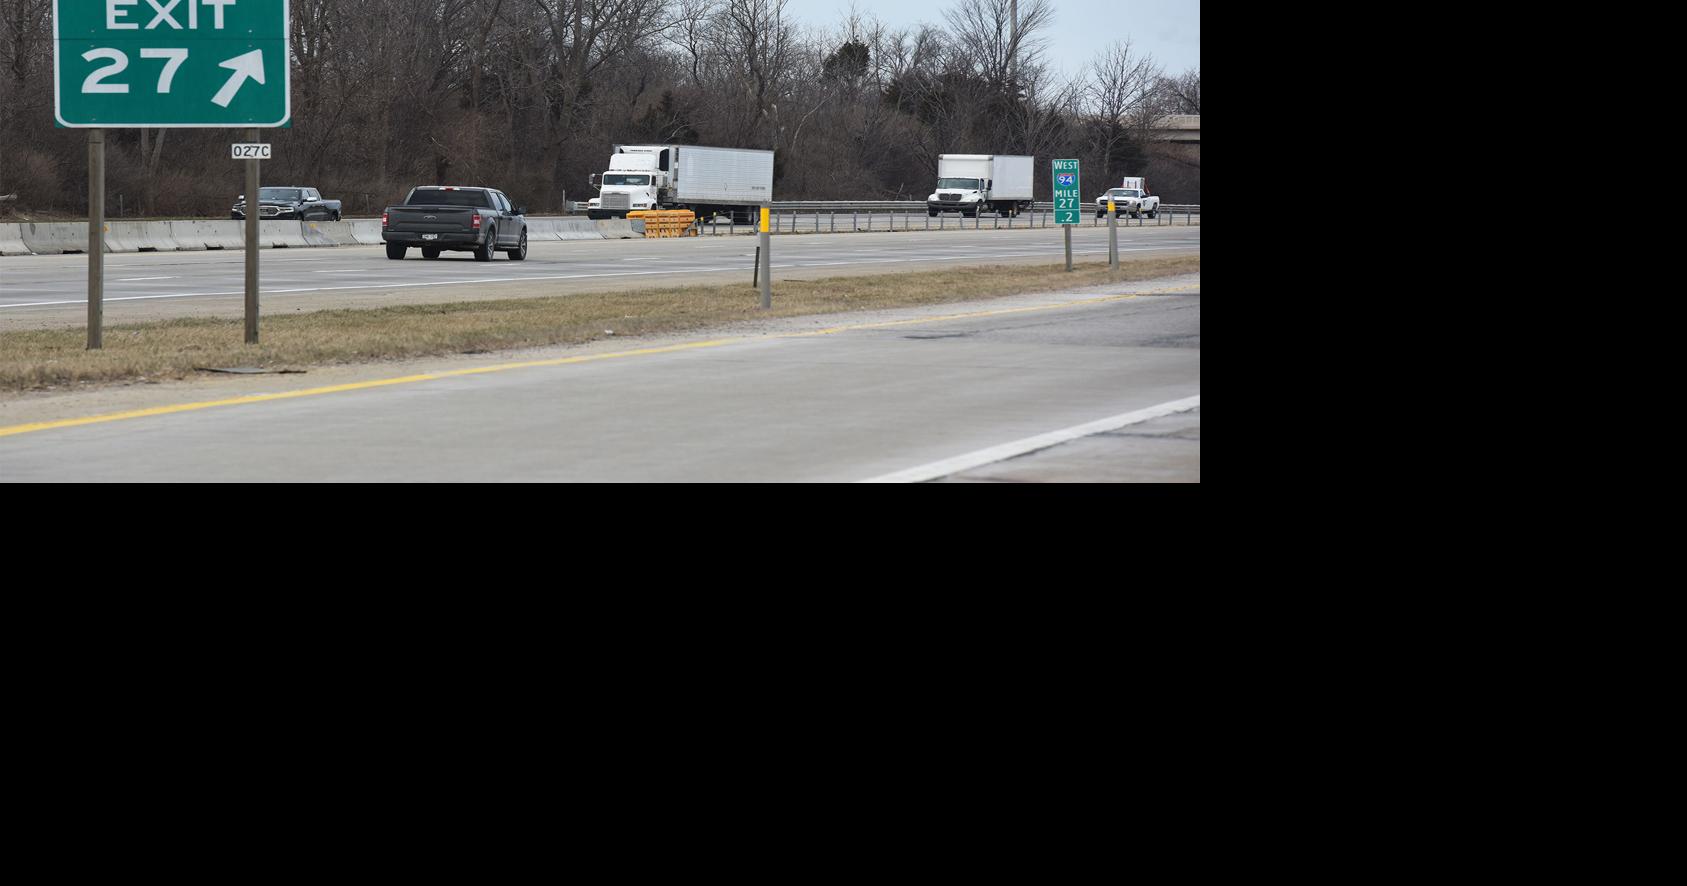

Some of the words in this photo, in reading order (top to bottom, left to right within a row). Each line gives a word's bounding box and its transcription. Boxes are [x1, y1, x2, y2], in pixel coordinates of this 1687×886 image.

[106, 0, 236, 30] EXIT
[81, 48, 188, 93] 27
[1054, 161, 1077, 170] WEST
[1058, 175, 1073, 184] 94
[1055, 189, 1078, 197] MILE
[1059, 198, 1074, 208] 27
